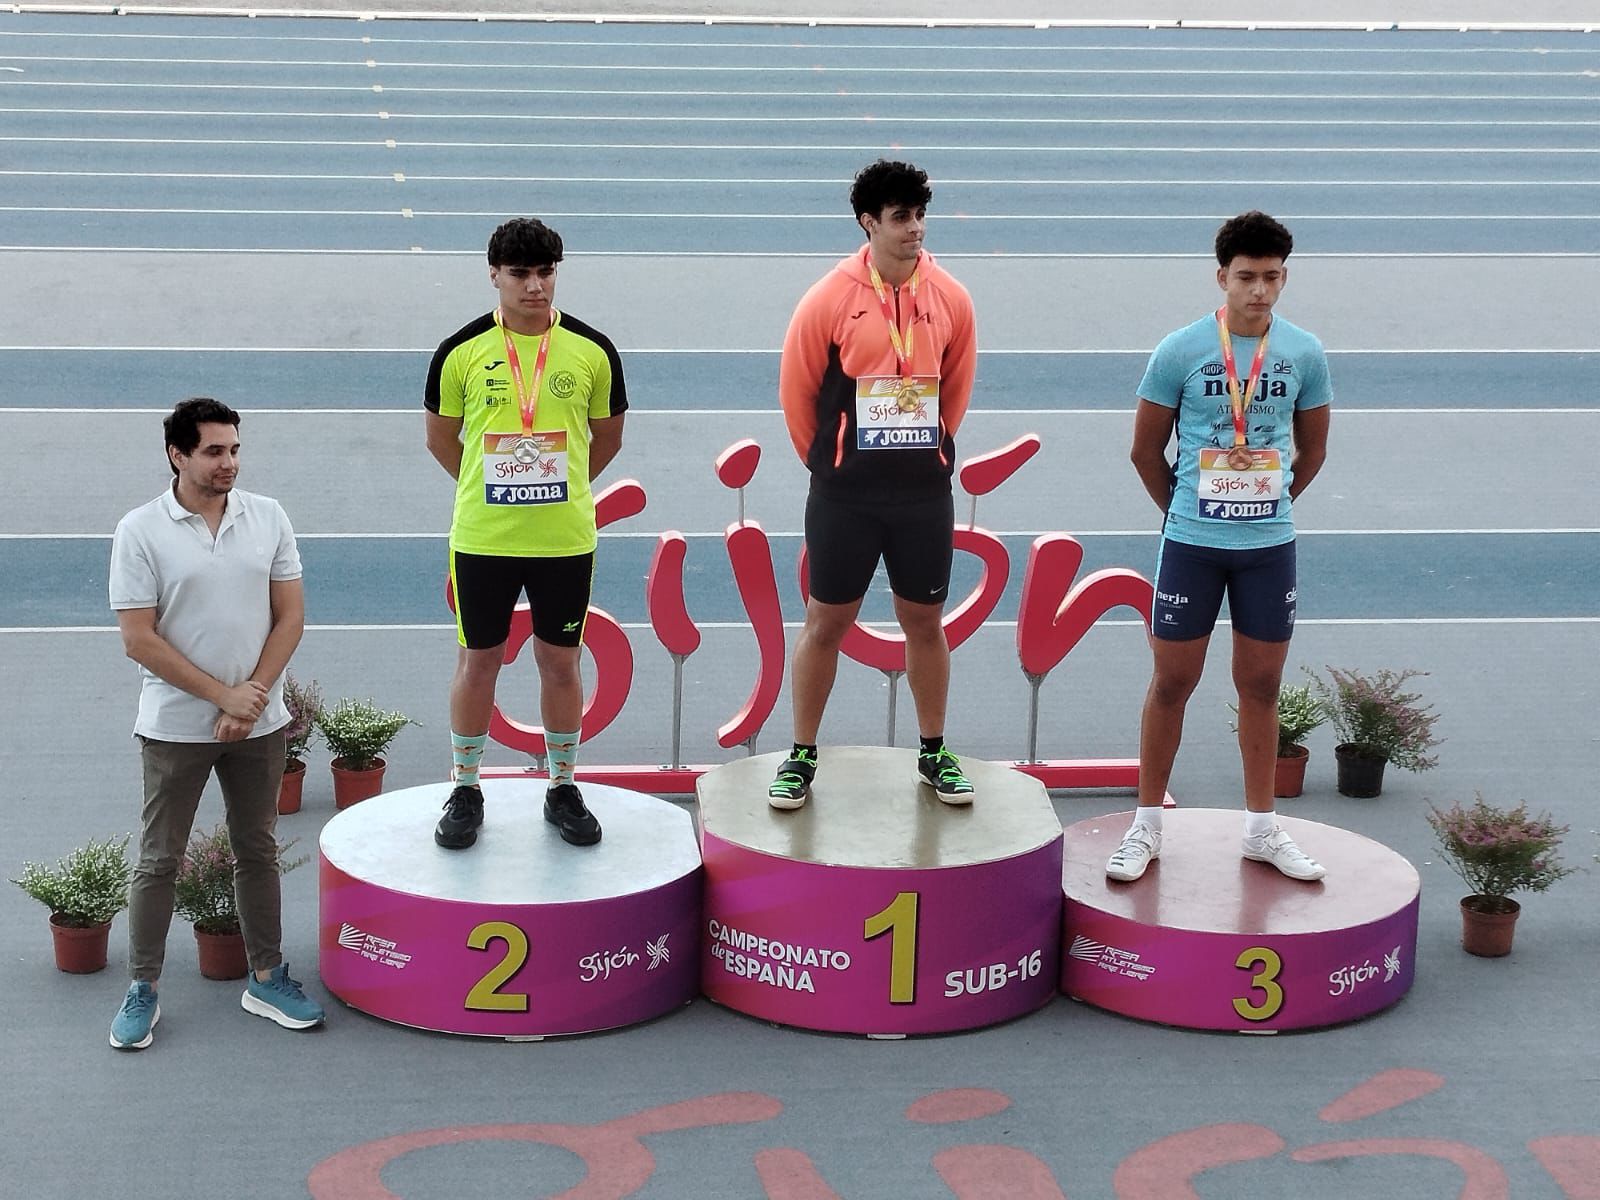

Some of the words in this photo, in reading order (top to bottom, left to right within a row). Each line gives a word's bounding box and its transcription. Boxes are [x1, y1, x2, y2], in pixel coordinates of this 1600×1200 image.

[1216, 404, 1275, 416] ATISMO
[1157, 591, 1189, 605] nerja
[464, 921, 529, 1012] 2
[579, 945, 640, 982] gijón
[708, 919, 851, 971] CAMPEONATO
[864, 891, 918, 1004] 1
[724, 950, 816, 993] ESPAÑA
[944, 949, 1042, 998] SUB-16
[1232, 946, 1284, 1022] 3
[1329, 959, 1379, 996] gijón
